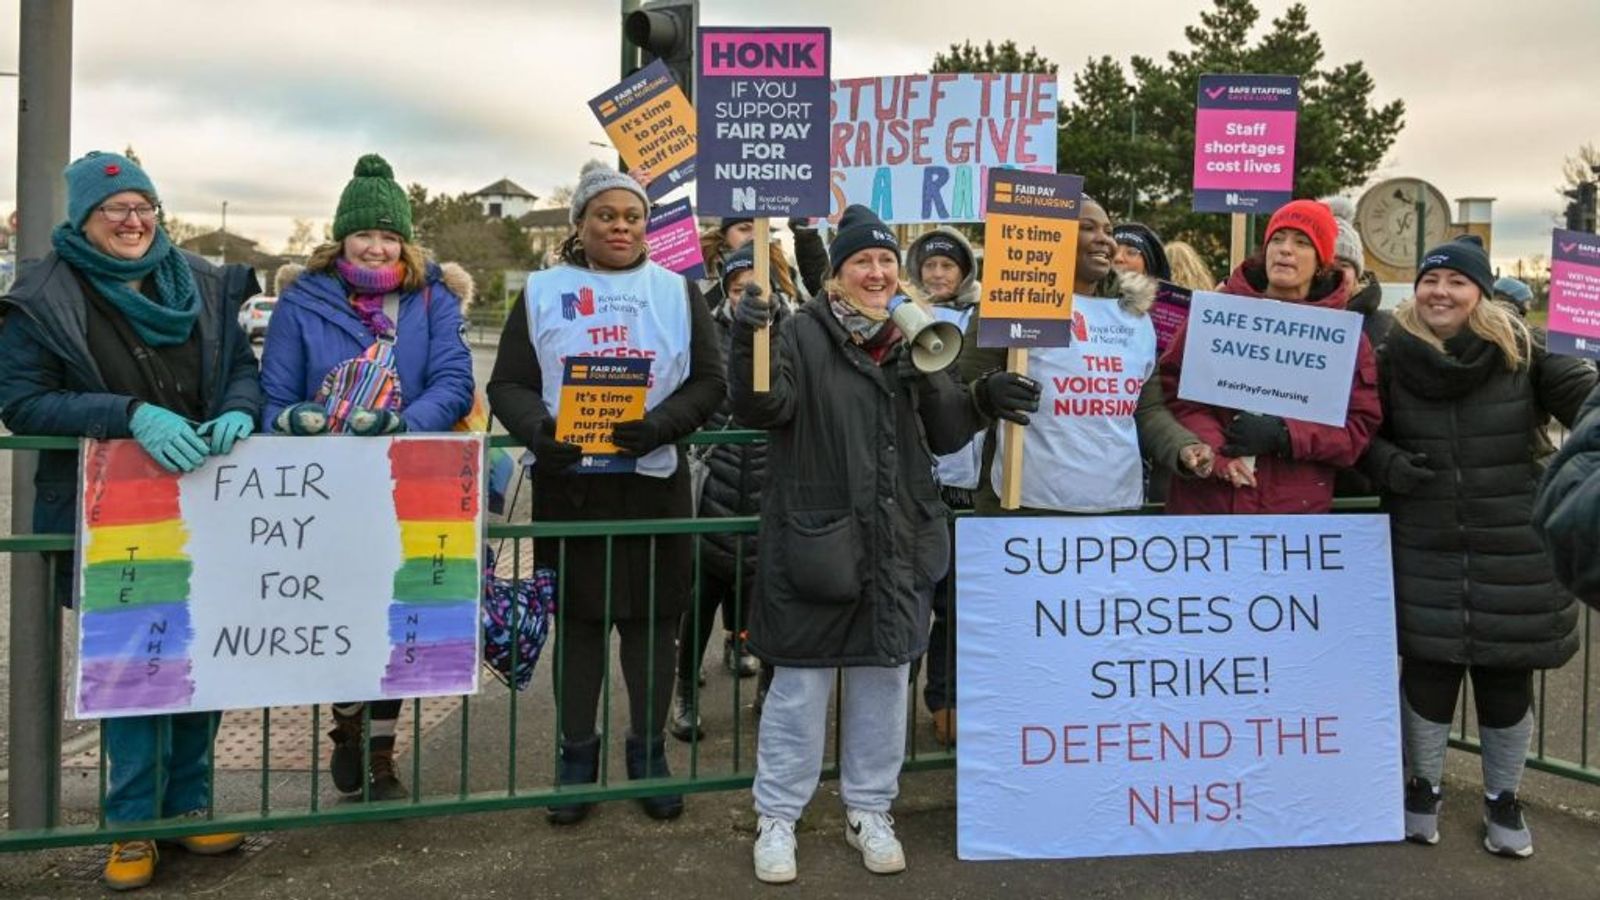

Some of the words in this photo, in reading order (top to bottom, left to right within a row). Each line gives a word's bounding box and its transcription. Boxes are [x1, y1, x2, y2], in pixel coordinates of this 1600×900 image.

[711, 42, 817, 69] HONK
[731, 81, 748, 98] IF
[753, 81, 797, 98] YOU
[974, 74, 1057, 118] THE
[1251, 86, 1292, 95] STAFFING
[620, 118, 641, 134] It's
[641, 100, 672, 120] time
[715, 101, 813, 119] SUPPORT
[634, 129, 649, 141] to
[650, 115, 673, 135] pay
[716, 122, 765, 139] FAIR
[769, 122, 812, 139] PAY
[1225, 122, 1267, 136] Staff
[638, 124, 687, 157] nursing
[741, 142, 786, 159] FOR
[945, 117, 1043, 165] GIVE
[1204, 140, 1285, 157] shortages
[639, 147, 667, 170] staff
[1206, 160, 1241, 172] cost
[1243, 159, 1282, 173] lives
[714, 163, 813, 180] NURSING
[828, 171, 846, 224] S
[870, 166, 894, 221] A
[1015, 183, 1035, 195] FAIR
[1037, 186, 1056, 197] PAY
[1014, 195, 1033, 206] FOR
[1033, 196, 1075, 209] NURSING
[1001, 223, 1024, 240] It's
[1027, 225, 1062, 242] time
[1008, 246, 1023, 260] to
[1026, 249, 1053, 266] pay
[1000, 267, 1057, 287] nursing
[989, 287, 1025, 302] staff
[1027, 288, 1065, 307] fairly
[587, 325, 628, 345] THE
[1201, 308, 1248, 329] SAFE
[1251, 316, 1347, 345] STAFFING
[1082, 355, 1124, 373] THE
[1210, 338, 1270, 361] SAVES
[1274, 348, 1327, 370] LIVES
[1052, 376, 1119, 394] VOICE
[1216, 378, 1310, 404] #FairPayForNursing
[575, 391, 598, 403] It's
[601, 391, 633, 403] time
[1054, 398, 1137, 416] NURSIN
[581, 406, 595, 416] to
[599, 407, 624, 418] pay
[573, 419, 614, 430] nursi
[562, 433, 596, 444] staff
[214, 462, 330, 501] FAIR
[250, 515, 315, 550] PAY
[1003, 535, 1239, 575] SUPPORT
[1250, 533, 1345, 572] THE
[261, 571, 324, 601] FOR
[1035, 596, 1233, 638] NURSES
[1247, 594, 1320, 633] ON
[213, 624, 352, 658] NURSES
[405, 613, 418, 664] NHS
[1091, 657, 1270, 699] STRIKE!
[1020, 720, 1232, 766] DEFEND
[1245, 716, 1342, 758] THE
[1128, 782, 1243, 826] NHS!
